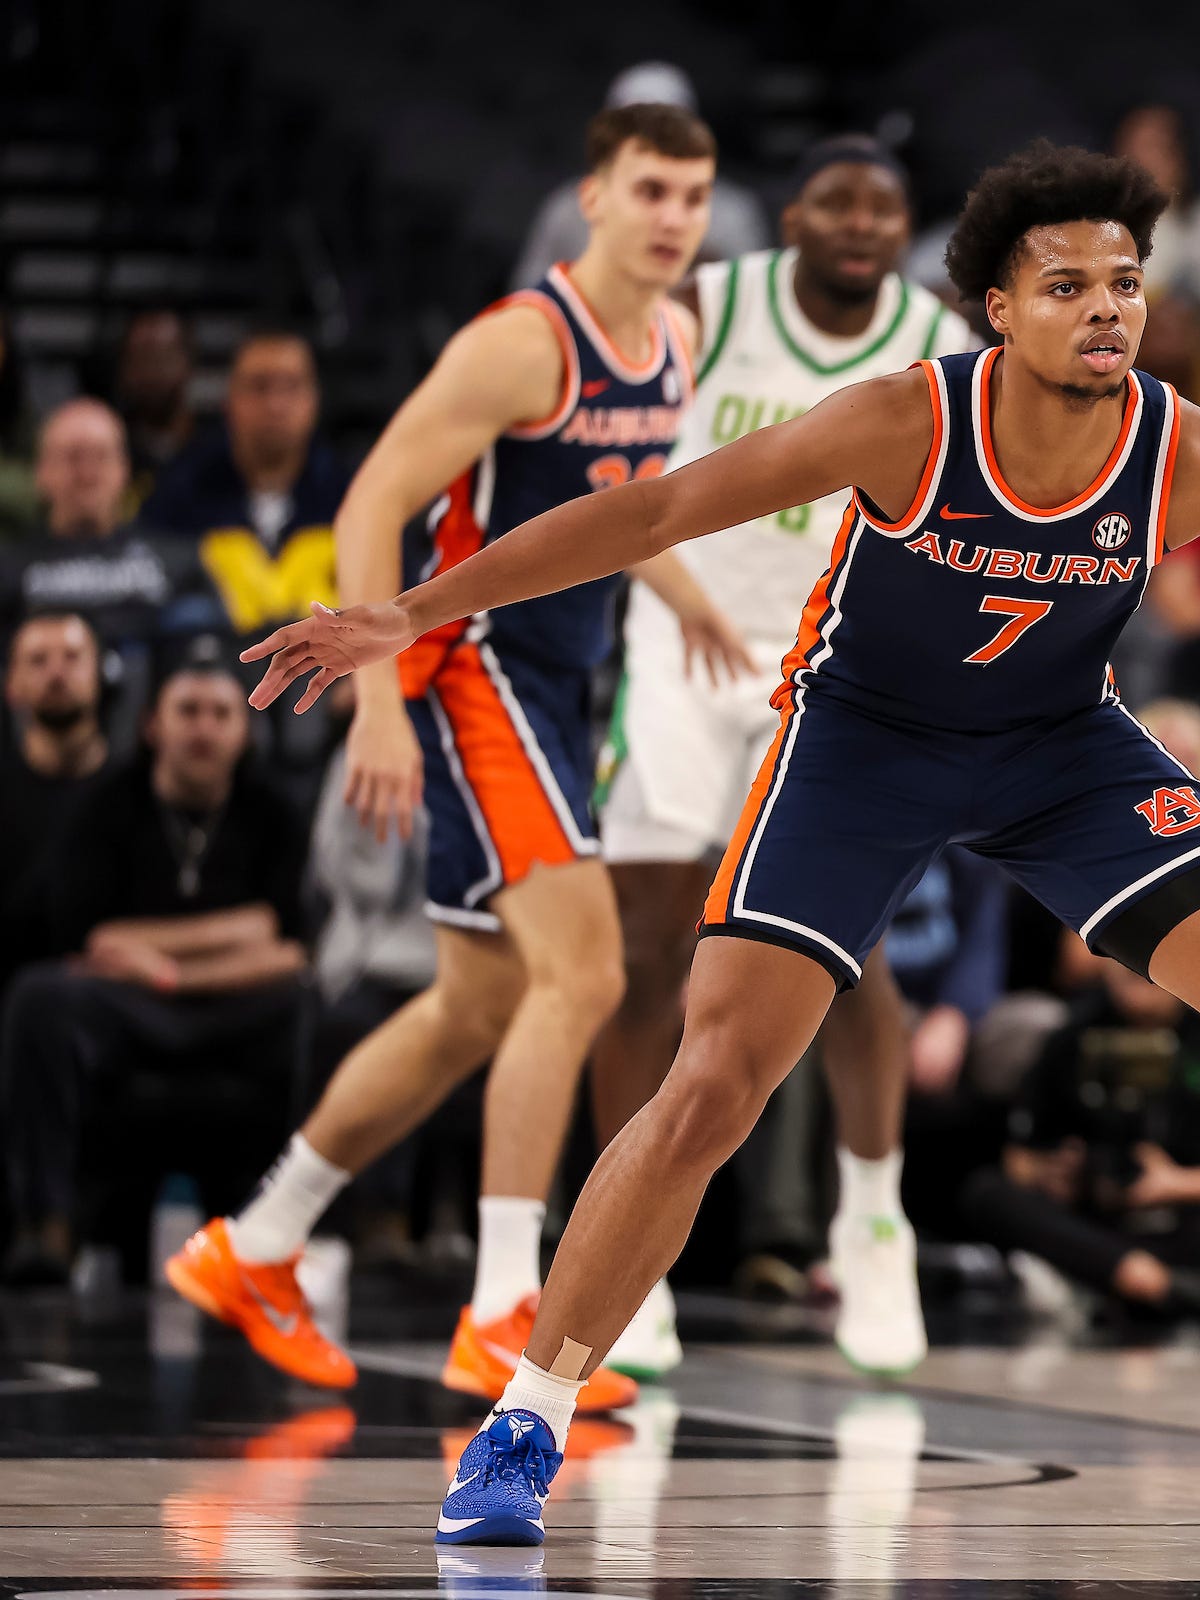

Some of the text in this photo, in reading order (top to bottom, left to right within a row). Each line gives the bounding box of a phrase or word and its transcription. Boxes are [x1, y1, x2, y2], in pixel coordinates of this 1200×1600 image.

[904, 532, 1141, 585] AUBURN
[1095, 516, 1130, 550] SEC
[963, 595, 1054, 664] 7
